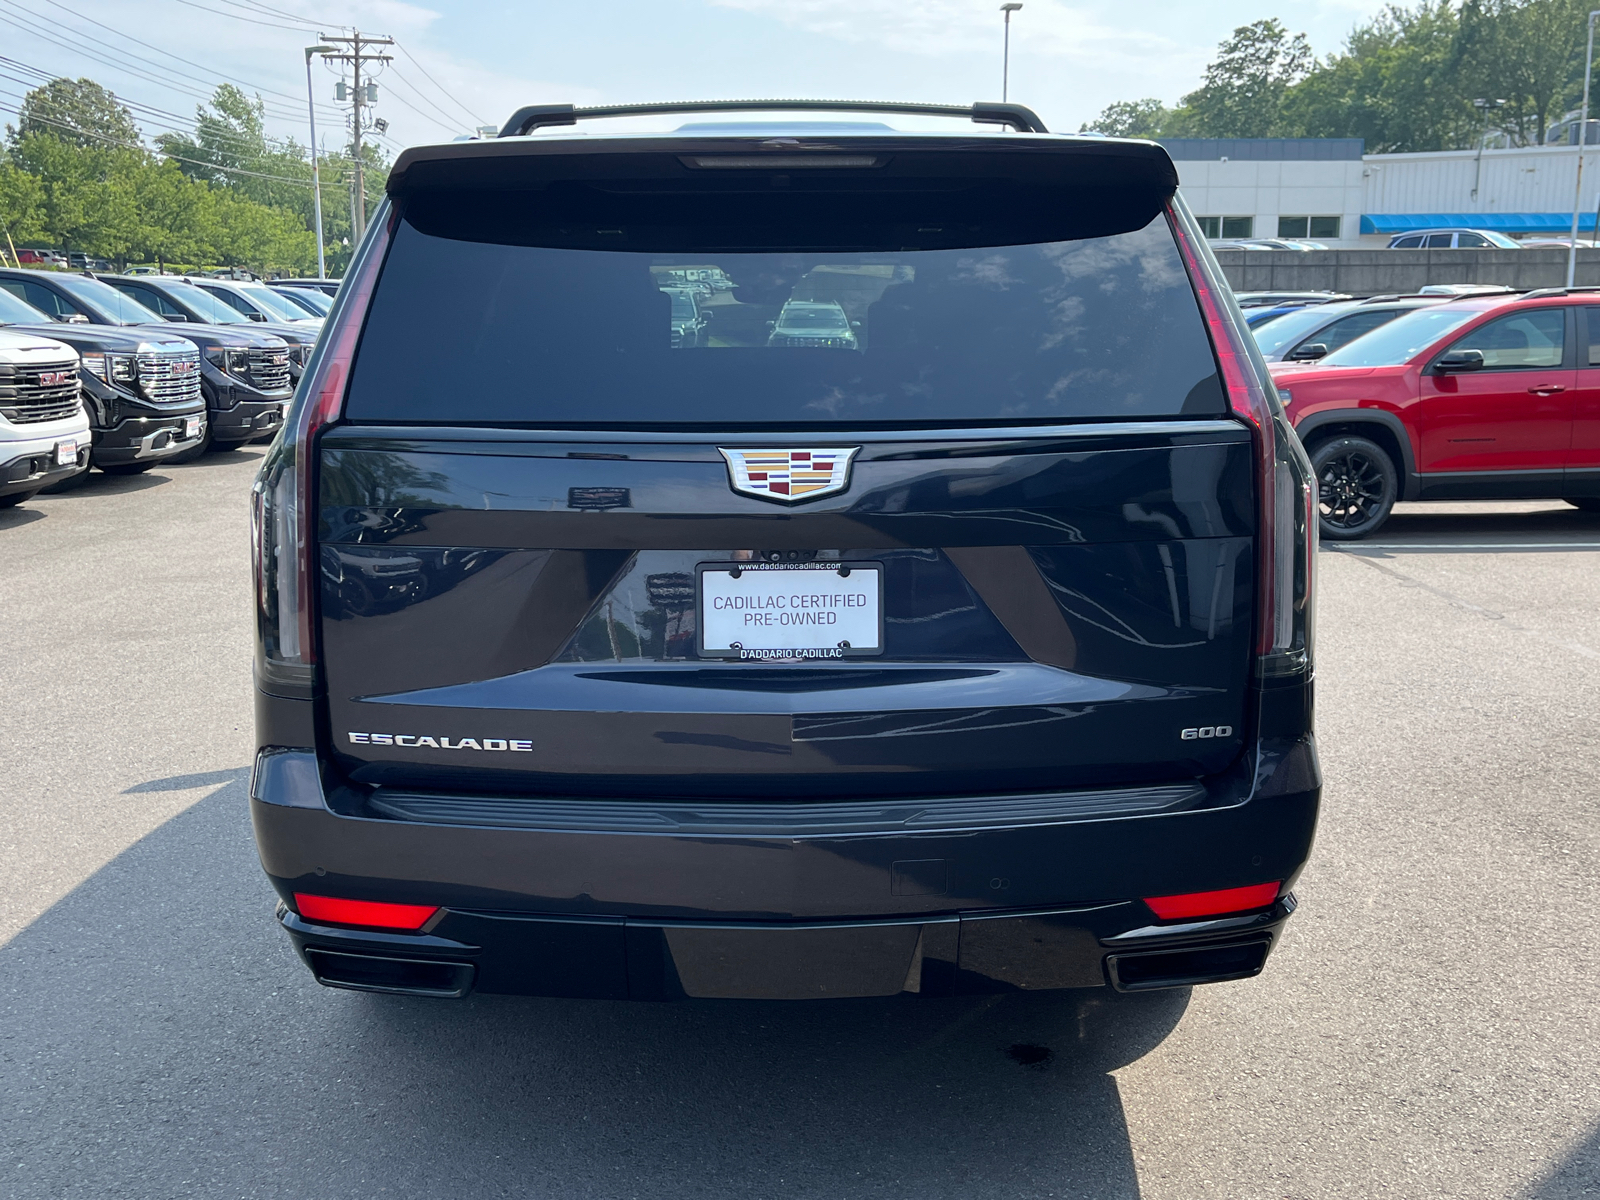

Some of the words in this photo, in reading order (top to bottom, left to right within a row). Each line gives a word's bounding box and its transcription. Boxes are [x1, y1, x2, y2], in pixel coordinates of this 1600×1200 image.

[39, 372, 70, 386] GMC
[713, 595, 786, 610] CADILLAC
[790, 593, 867, 608] CERTIFIED
[744, 611, 837, 626] PRE-OWNED
[740, 649, 793, 659] D'ADDARIO
[795, 648, 843, 658] CADILLAC
[1181, 725, 1233, 740] 600
[347, 731, 533, 752] ESCALADE
